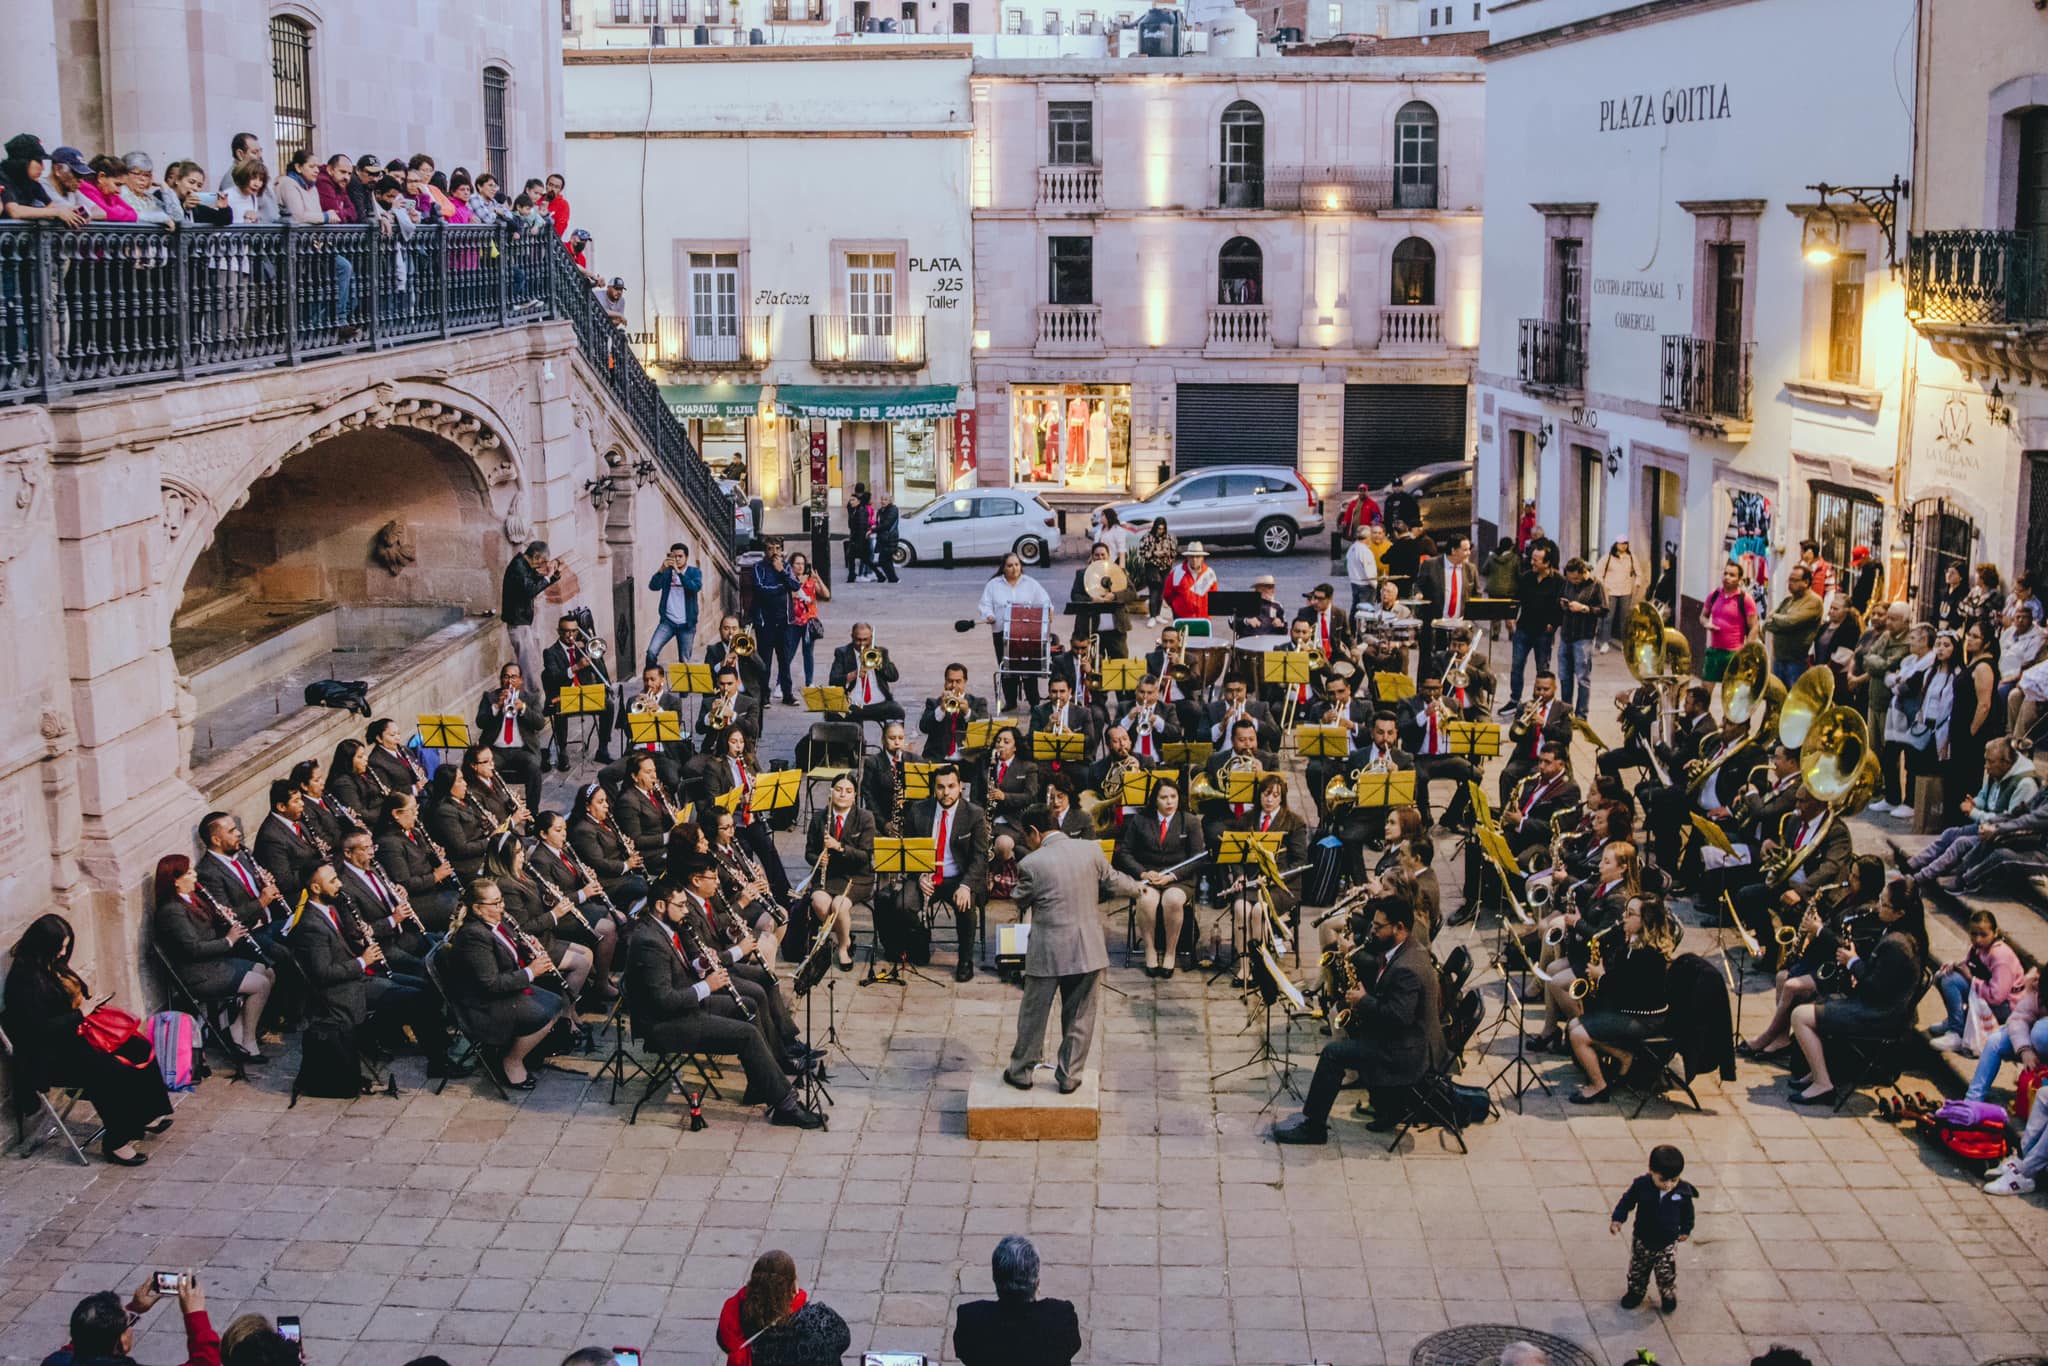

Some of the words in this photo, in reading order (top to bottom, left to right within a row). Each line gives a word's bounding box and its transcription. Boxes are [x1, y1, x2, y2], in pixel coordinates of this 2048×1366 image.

[1599, 95, 1656, 132] PLAZA
[1662, 82, 1731, 124] GOITIA
[908, 257, 962, 272] PLATA
[933, 277, 963, 291] .925
[1593, 279, 1620, 296] CENTRO
[1621, 280, 1664, 299] ARTESANAL
[1677, 283, 1684, 300] Y
[925, 295, 960, 309] Taller
[1615, 312, 1656, 331] COMERCIAL
[676, 404, 718, 414] CHAPATAS
[776, 403, 792, 415] EL
[799, 405, 853, 418] TESORO
[860, 406, 879, 418] DE
[885, 402, 956, 418] ZACATECAS
[1572, 406, 1598, 428] OXXO
[959, 412, 971, 471] PLATA
